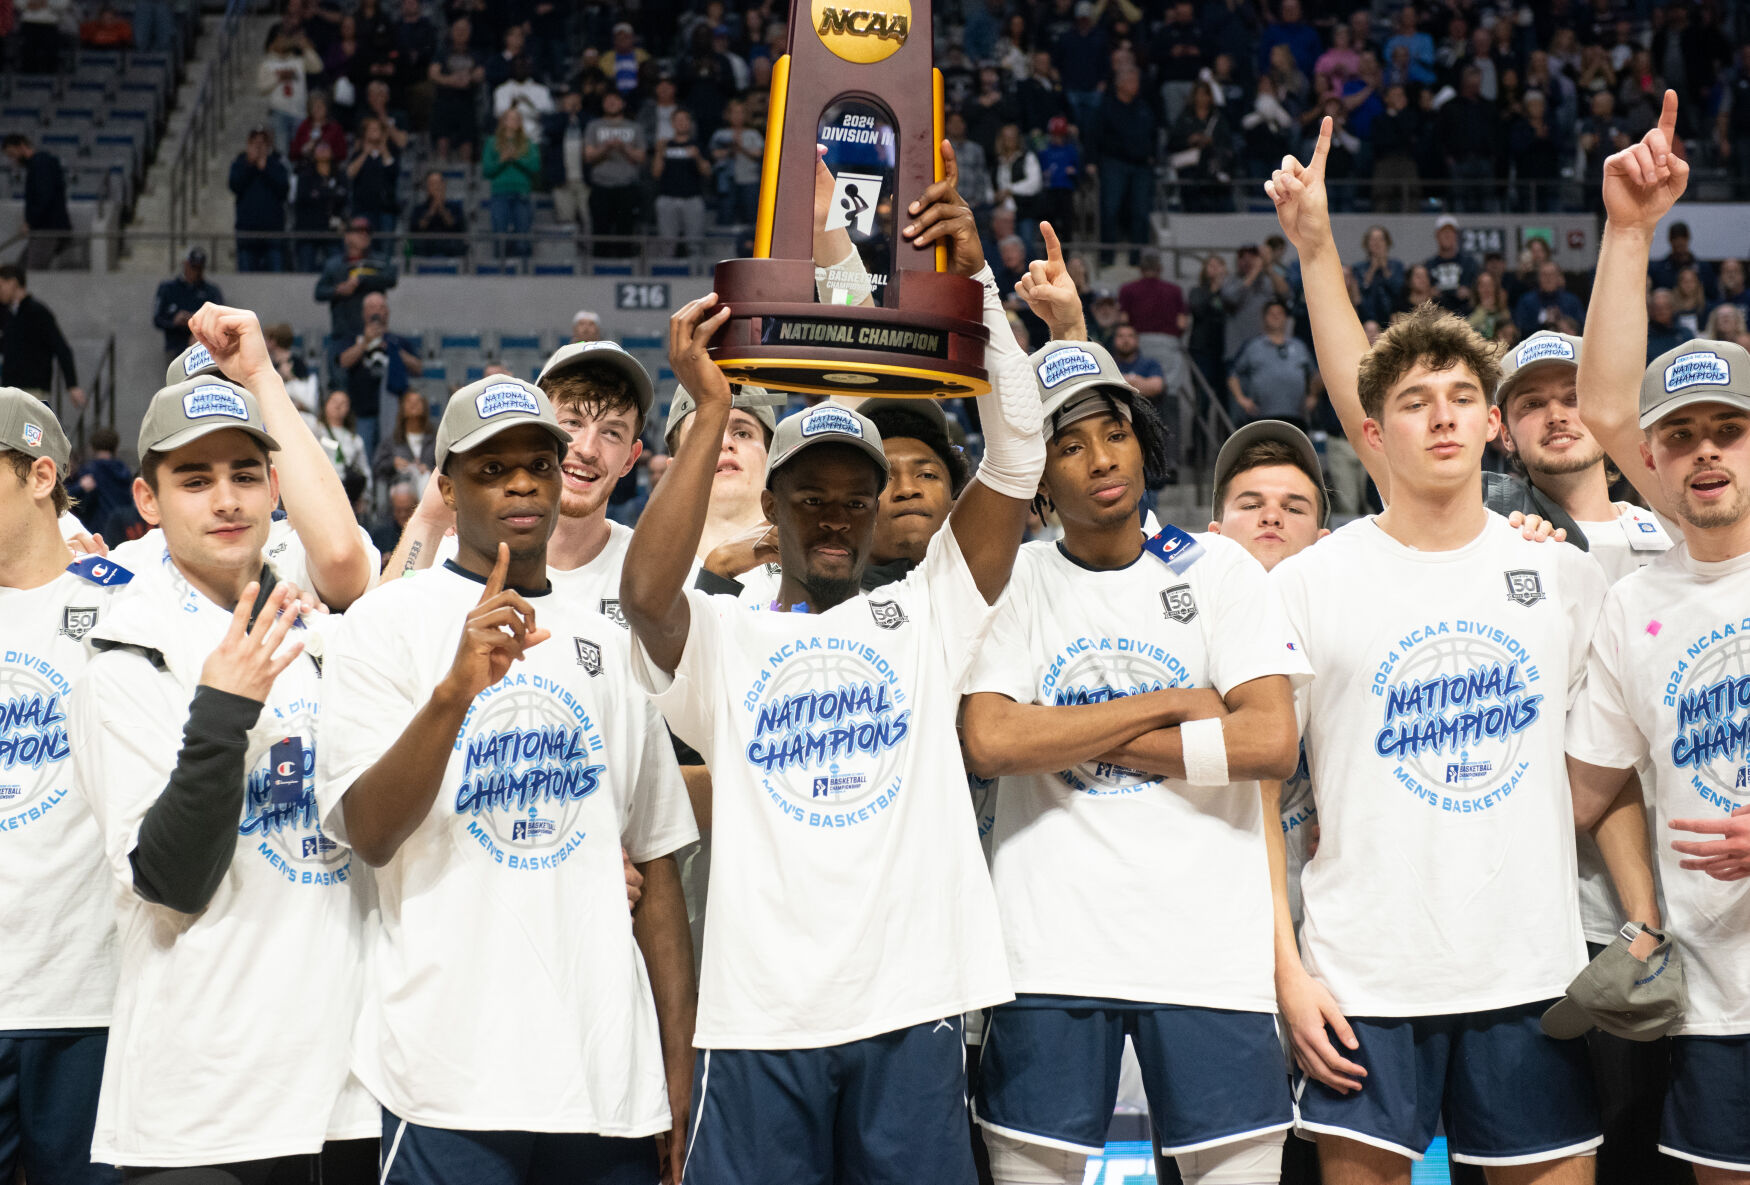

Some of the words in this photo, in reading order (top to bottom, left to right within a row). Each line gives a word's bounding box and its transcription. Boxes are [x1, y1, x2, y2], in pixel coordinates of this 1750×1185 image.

[818, 7, 909, 46] NCAA
[842, 114, 875, 129] 2024
[821, 126, 879, 145] DIVISION
[827, 269, 888, 286] BASKETBALL
[622, 284, 665, 307] 216
[780, 322, 854, 343] NATIONAL
[858, 328, 939, 351] CHAMPION
[1520, 350, 1571, 365] CHAMPIONS
[1523, 342, 1564, 357] NATIONAL
[1046, 355, 1090, 373] NATIONAL
[1046, 363, 1096, 384] CHAMPIONS
[1672, 361, 1720, 377] NATIONAL
[1668, 371, 1727, 387] CHAMPIONS
[192, 393, 239, 405] NATIONAL
[482, 400, 536, 413] CHAMPIONS
[485, 392, 530, 403] NATIONAL
[190, 403, 244, 415] CHAMPIONS
[809, 414, 855, 425] NATIONAL
[1513, 579, 1536, 592] 50
[1169, 592, 1193, 610] 50
[69, 614, 92, 628] 50
[875, 606, 898, 621] 50
[582, 647, 598, 664] 50
[1372, 651, 1400, 697] 2024
[1398, 621, 1450, 652] NCAA
[1456, 620, 1531, 665] DIVISION
[1525, 665, 1541, 683] III
[1664, 660, 1689, 707] 2024
[1686, 623, 1737, 660] NCAA
[5, 650, 72, 696] DIVISION
[744, 669, 772, 713] 2024
[769, 636, 822, 668] NCAA
[827, 638, 899, 686] DIVISION
[1043, 655, 1067, 697] 2024
[1118, 637, 1190, 682] DIVISION
[1384, 659, 1526, 726] NATIONAL
[533, 675, 594, 731] DIVISION
[588, 734, 604, 751] III
[755, 680, 895, 739] NATIONAL
[1375, 694, 1544, 761] CHAMPIONS
[746, 709, 911, 773] CHAMPIONS
[465, 724, 588, 783] NATIONAL
[455, 762, 606, 816] CHAMPIONS
[830, 776, 867, 786] BASKETBALL
[1393, 766, 1439, 806] MEN'S
[1442, 760, 1530, 813] BASKETBALL
[762, 778, 805, 822] MEN'S
[809, 775, 902, 828] BASKETBALL
[1691, 774, 1732, 813] MEN'S
[466, 821, 504, 863] MEN'S
[508, 830, 586, 870] BASKETBALL
[258, 841, 297, 882] MEN'S
